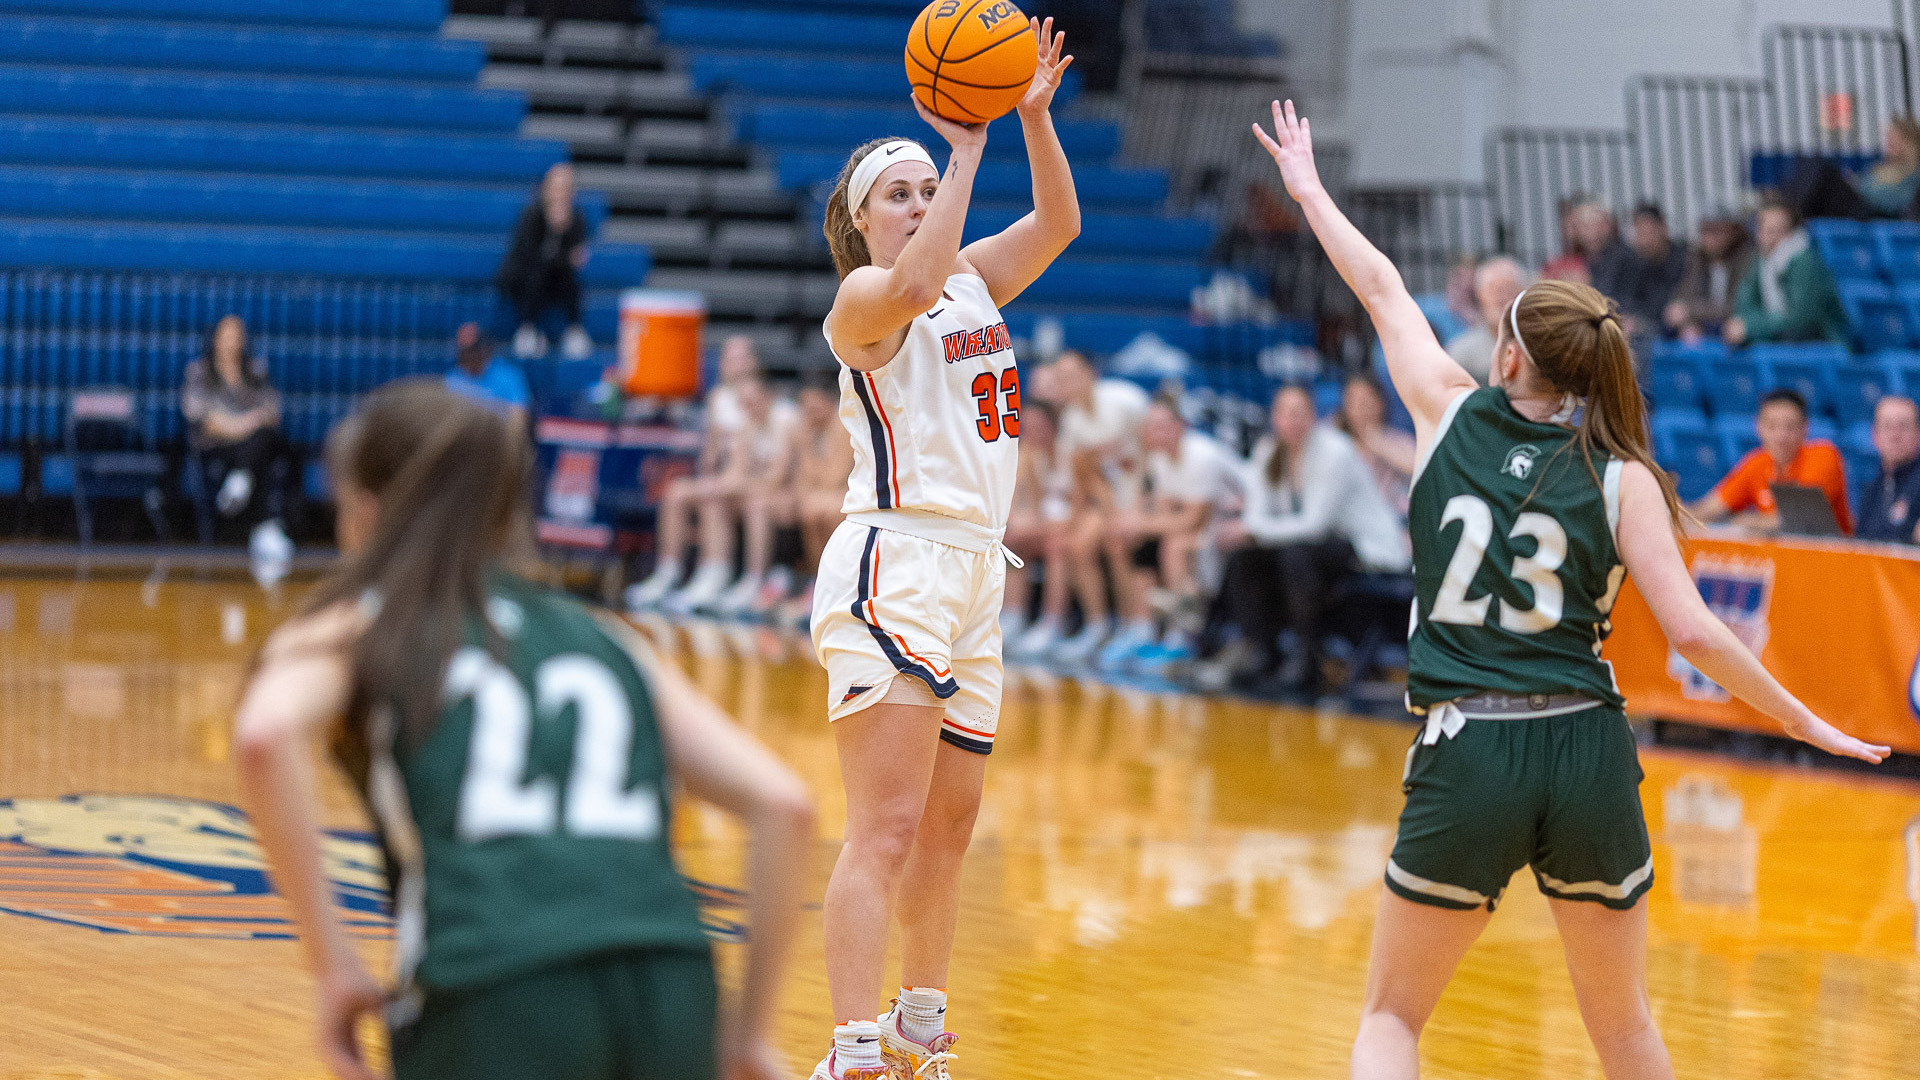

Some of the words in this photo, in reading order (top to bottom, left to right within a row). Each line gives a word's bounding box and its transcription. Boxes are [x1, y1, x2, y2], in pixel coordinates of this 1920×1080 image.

[941, 321, 1012, 364] WHEATO
[971, 366, 1020, 443] 33
[1428, 495, 1568, 635] 23
[446, 649, 661, 841] 22
